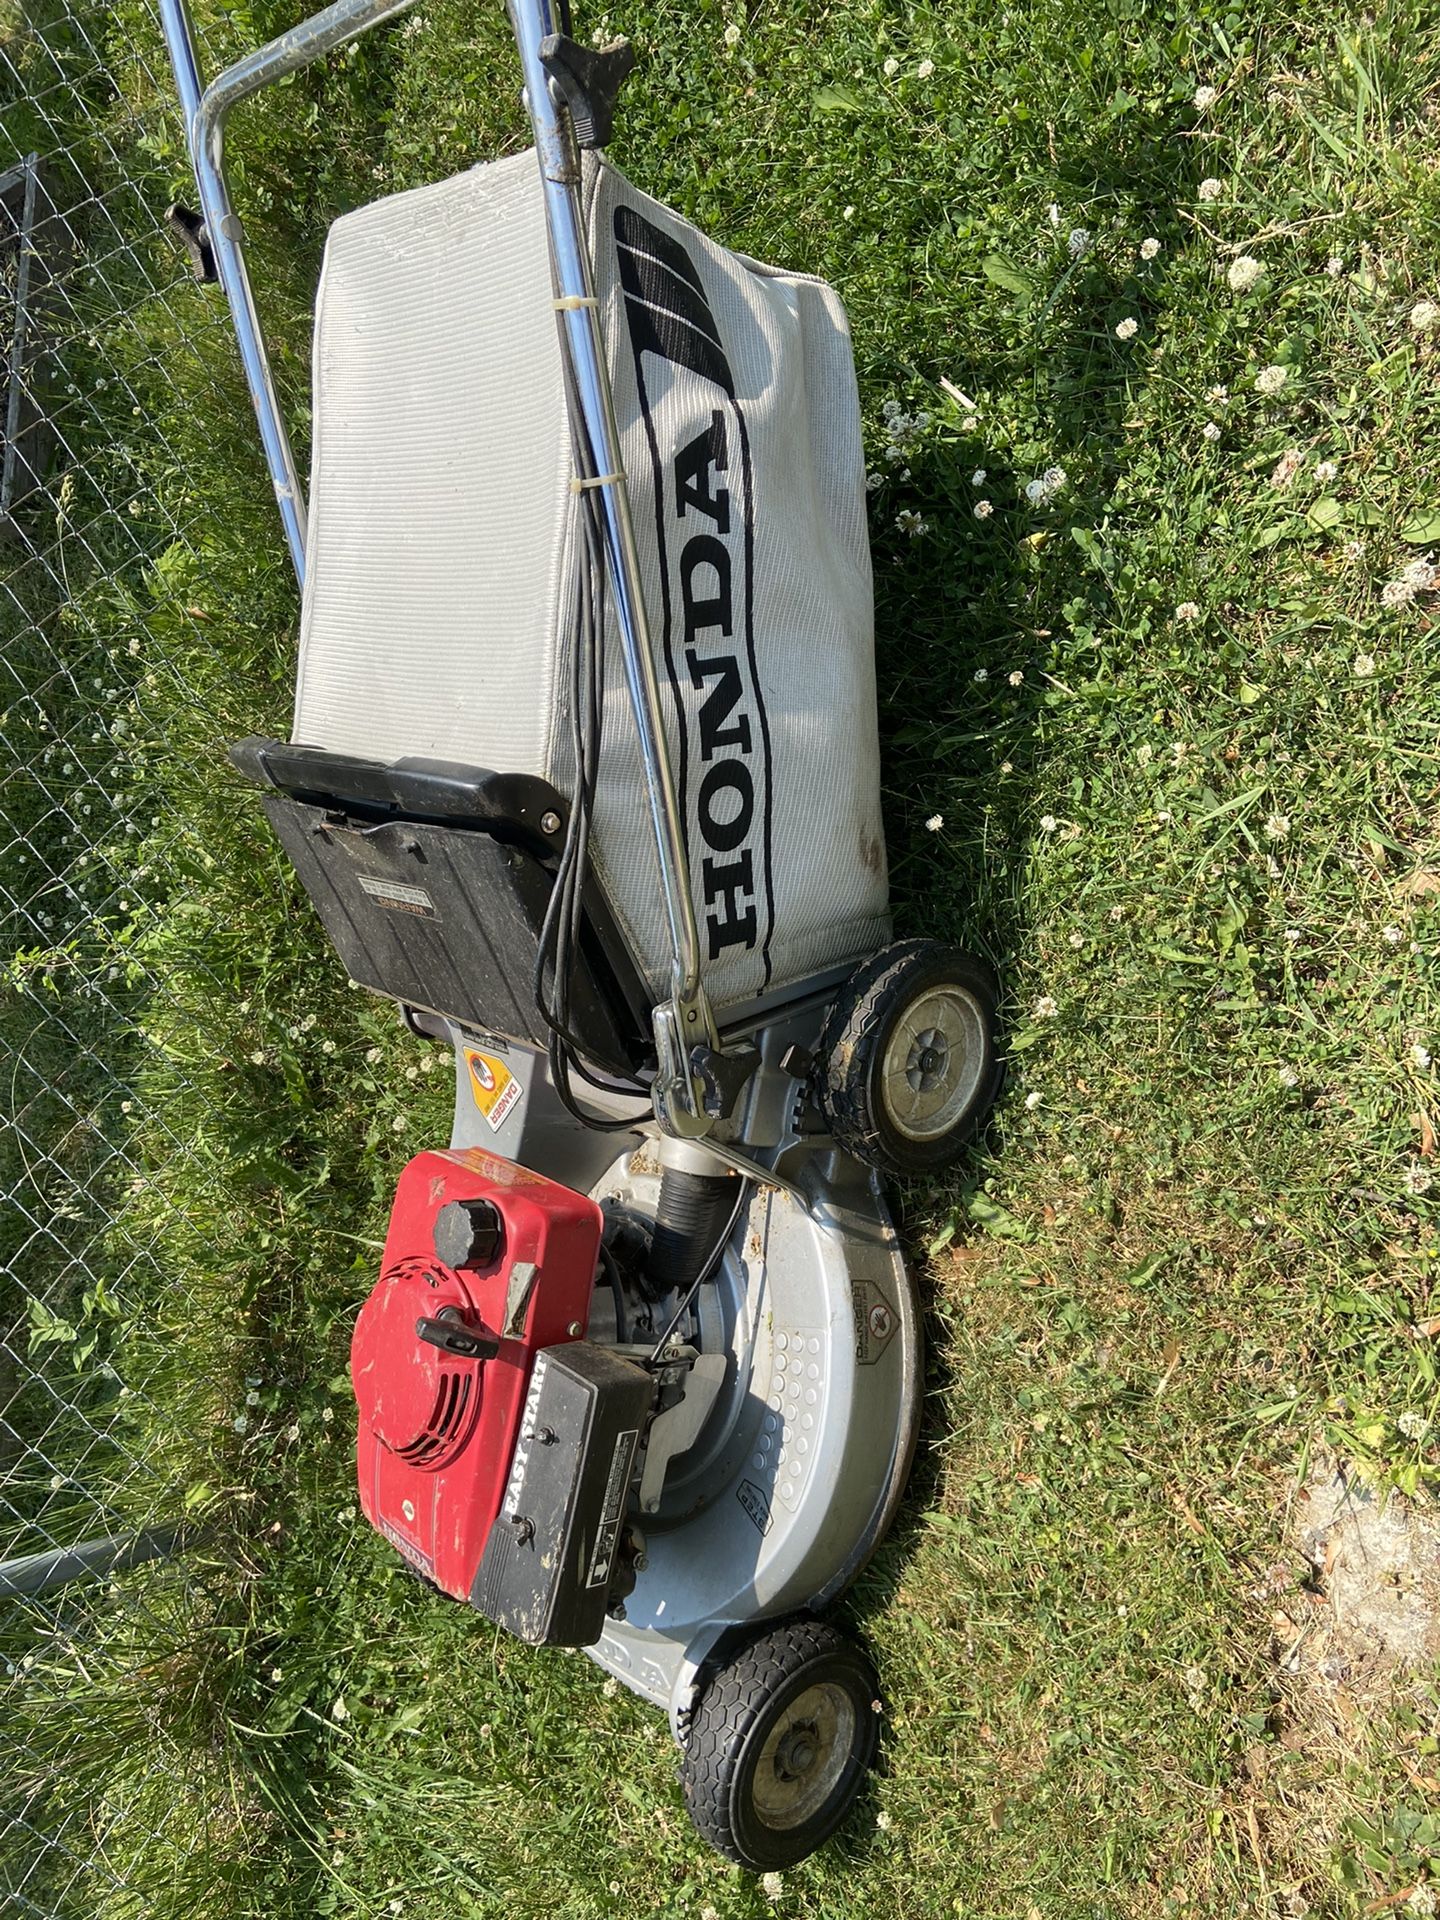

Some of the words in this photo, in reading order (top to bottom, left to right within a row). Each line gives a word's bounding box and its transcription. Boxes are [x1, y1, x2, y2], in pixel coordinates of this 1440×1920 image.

[675, 409, 758, 960] HONDA
[489, 1083, 519, 1125] DANGER
[504, 1442, 530, 1516] EASY
[521, 1355, 547, 1441] START
